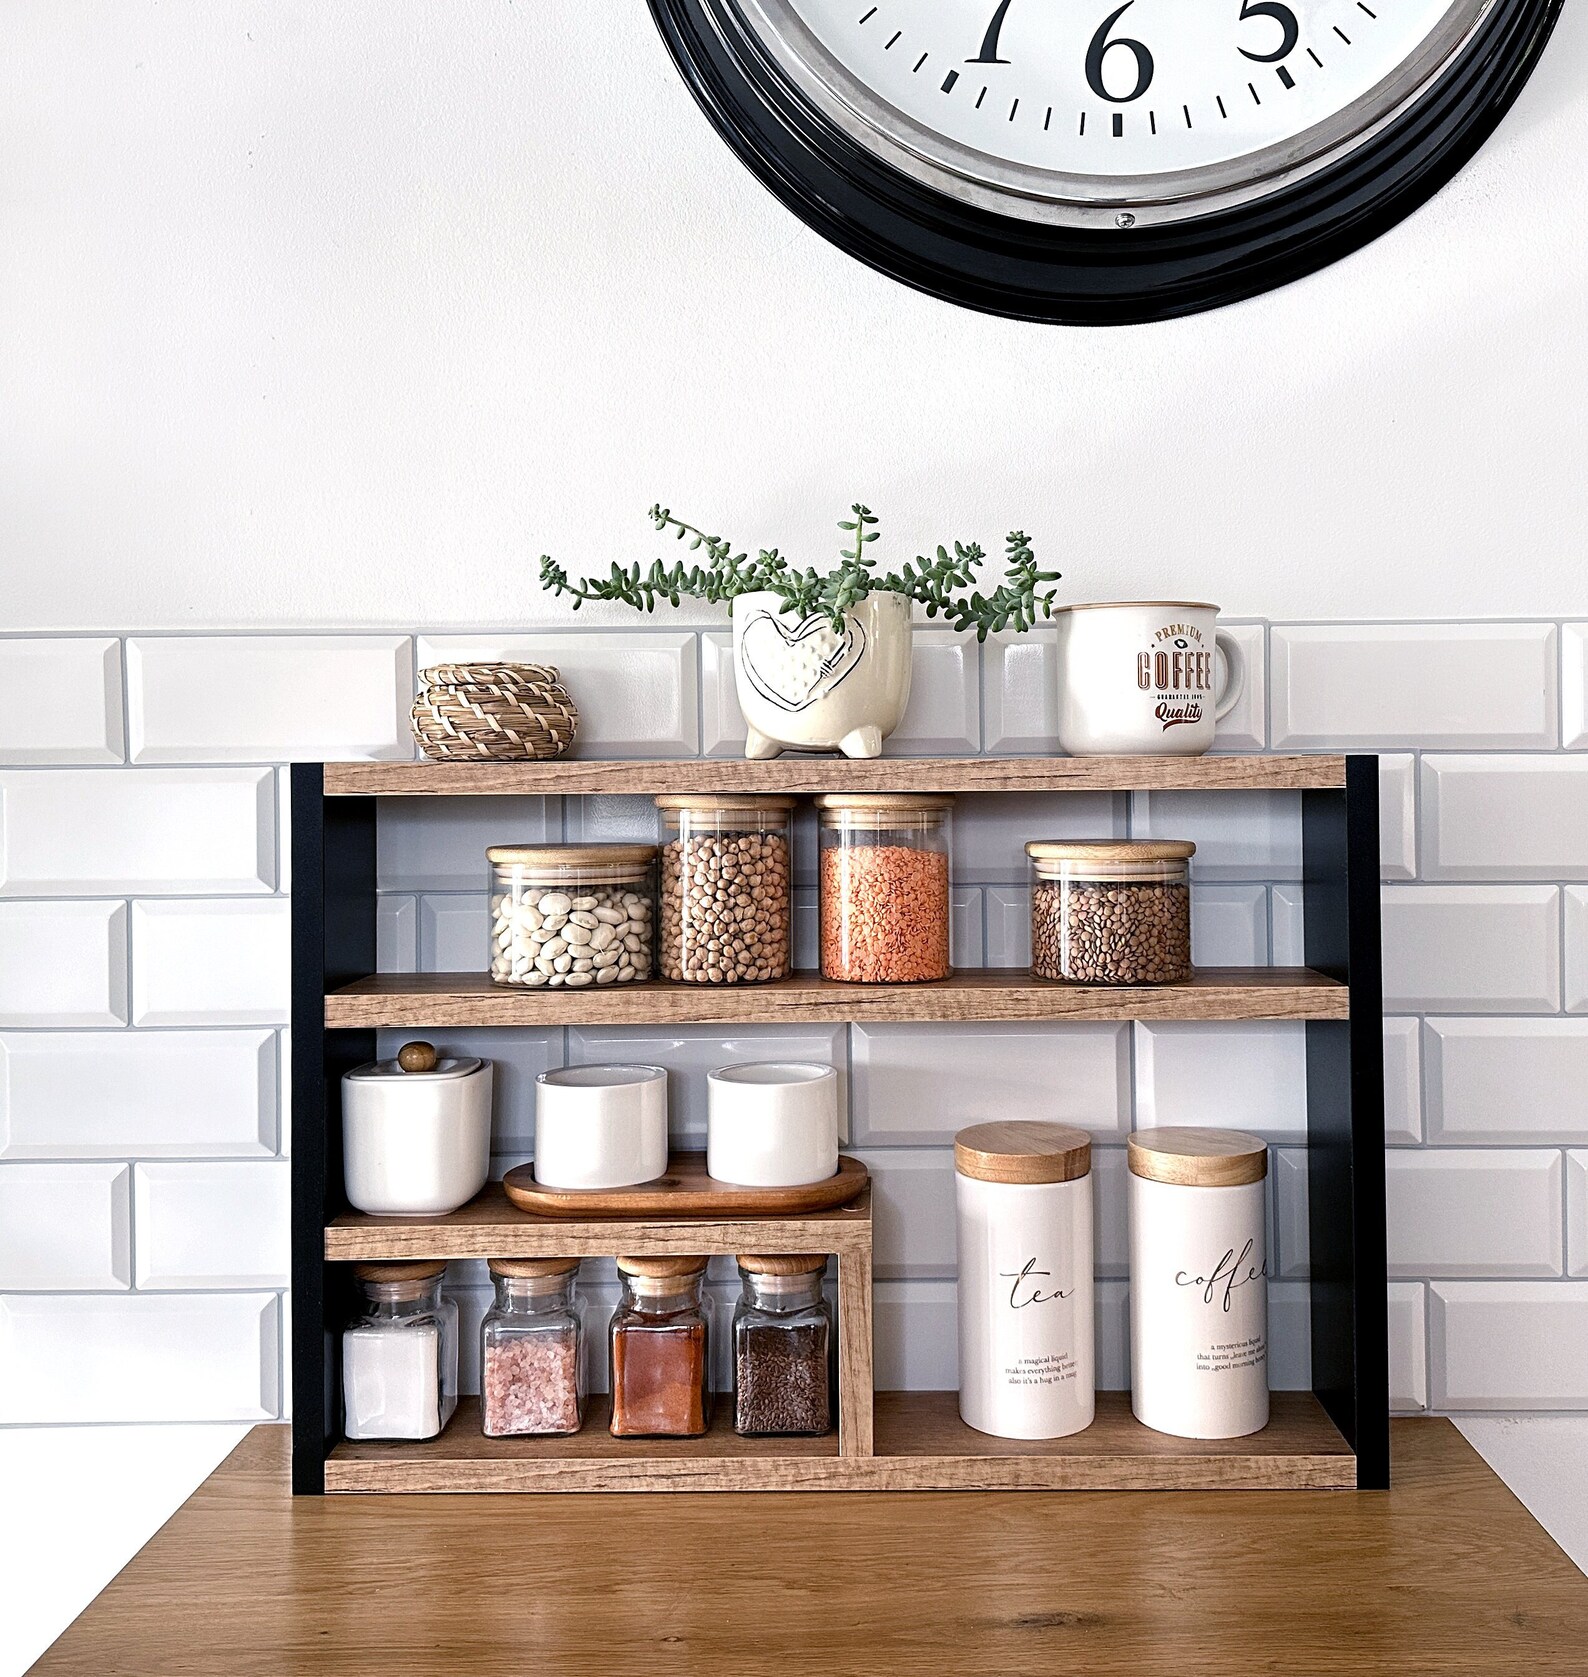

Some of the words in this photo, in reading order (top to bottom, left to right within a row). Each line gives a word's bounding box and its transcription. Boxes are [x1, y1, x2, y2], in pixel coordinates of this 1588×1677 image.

[1236, 0, 1299, 63] 5
[1085, 0, 1154, 103] 6
[1154, 623, 1203, 642] PREMIUM
[1137, 650, 1211, 691] COFFEE
[1154, 701, 1203, 733] Quality
[999, 1257, 1075, 1309] tea
[1024, 1356, 1050, 1365] magical
[1051, 1352, 1068, 1363] liquid
[1216, 1341, 1248, 1351] mysterious
[1027, 1365, 1061, 1375] everything
